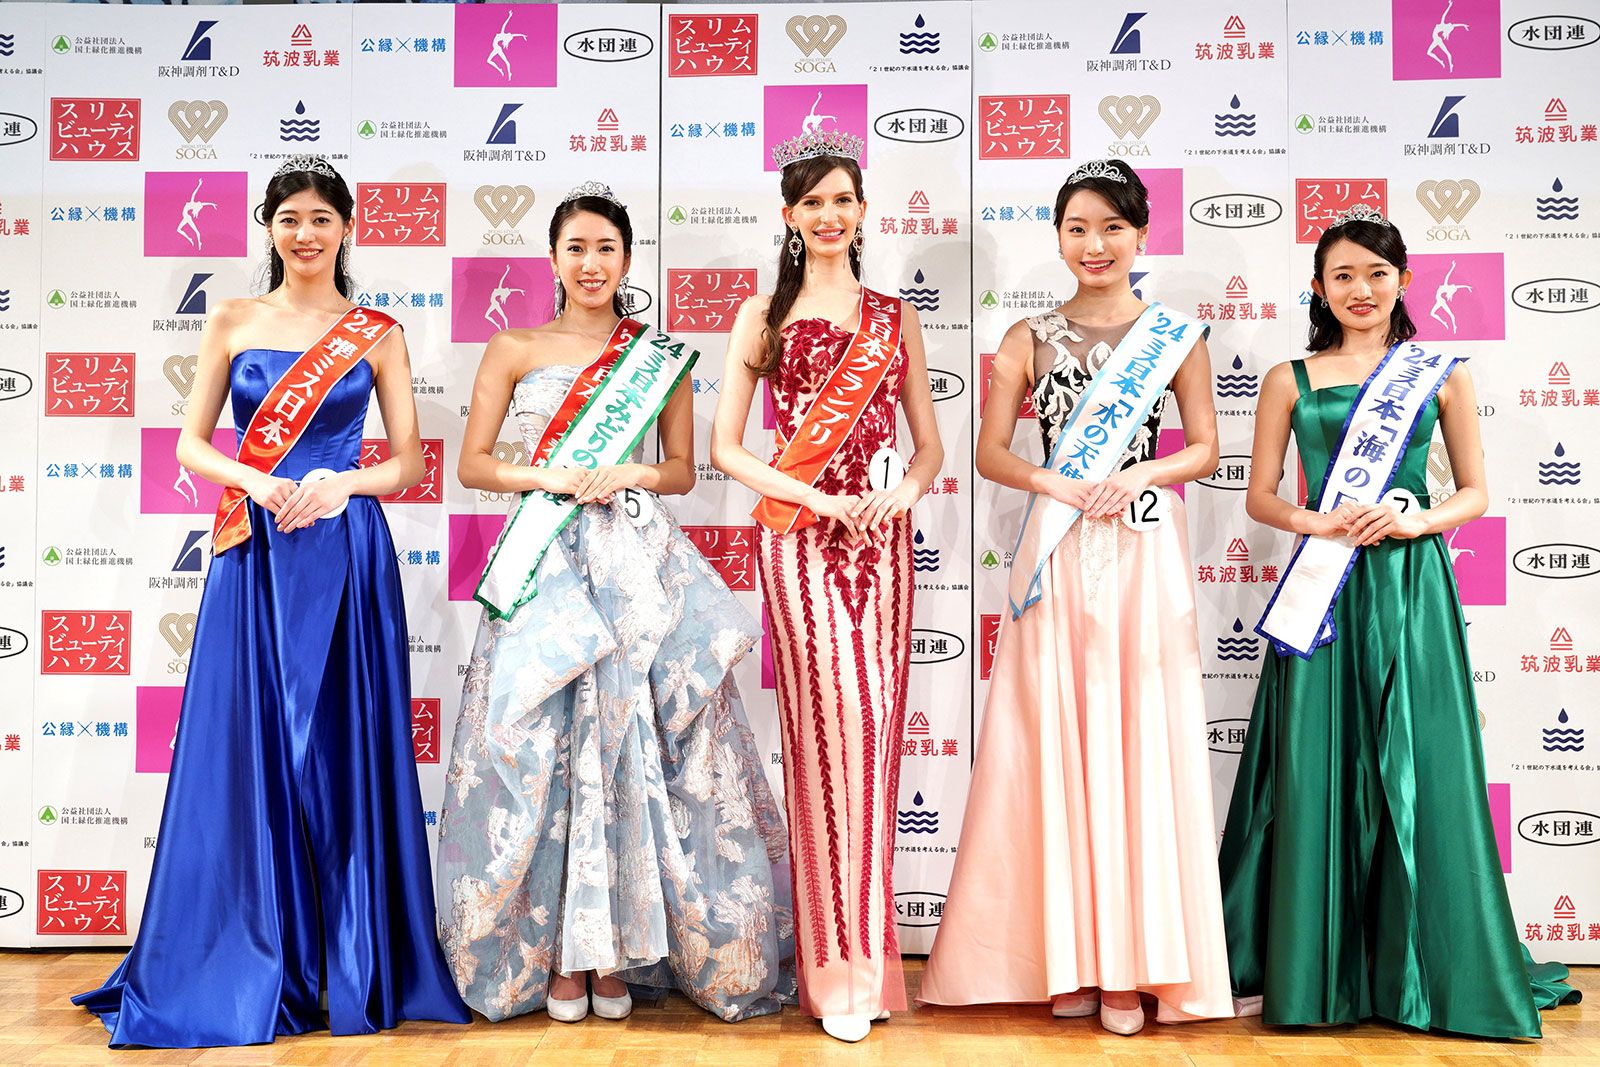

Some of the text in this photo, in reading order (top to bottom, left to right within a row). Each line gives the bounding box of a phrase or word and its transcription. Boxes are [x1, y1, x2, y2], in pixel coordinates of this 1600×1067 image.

[675, 19, 752, 35] スリム
[1522, 25, 1585, 41] 水団連
[74, 37, 125, 45] 公益社団法人
[578, 38, 637, 52] 水団連
[1002, 33, 1053, 41] 公益社団法人
[675, 37, 752, 55] ビューティ
[1195, 42, 1274, 60] 筑波乳業
[263, 50, 339, 67] 筑波乳業
[675, 56, 752, 72] ハウス
[794, 60, 836, 73] SOGA
[1087, 59, 1171, 71] 阪神調剤 T&D
[159, 66, 239, 77] 阪神調剤 T&D
[56, 102, 135, 120] スリム
[985, 100, 1065, 116] スリム
[56, 121, 135, 140] ビューティ
[888, 118, 947, 133] 水団連
[985, 117, 1065, 137] ビューティ
[1515, 125, 1597, 143] 筑波乳業
[56, 140, 135, 157] ハウス
[570, 135, 646, 152] 筑波乳業
[985, 138, 1065, 156] ハウス
[1108, 144, 1151, 156] SOGA
[1404, 143, 1490, 155] 阪神調剤 T&D
[176, 147, 217, 159] SOGA
[464, 150, 545, 161] 阪神調剤 T&D
[363, 187, 440, 205] スリム
[1303, 183, 1381, 201] スリム
[363, 206, 440, 225] ビューティ
[982, 206, 1050, 221] 公縁×機
[1204, 203, 1265, 219] 水団連
[363, 225, 440, 243] ハウス
[880, 217, 958, 235] 筑波乳業
[1426, 227, 1471, 241] SOGA
[483, 234, 525, 245] SOGA
[676, 272, 752, 290] スリム
[1004, 291, 1053, 299] 公益社団法人
[1527, 288, 1588, 303] 水団連
[1197, 303, 1276, 320] 筑波乳業
[153, 320, 202, 331] 阪神調剤
[52, 357, 129, 375] スリム
[52, 376, 129, 395] ビューティ
[52, 396, 129, 414] ハウス
[1520, 389, 1599, 407] 筑波乳業
[883, 455, 890, 490] 1
[624, 488, 641, 519] 5
[66, 548, 116, 556] 公益社団法人
[1527, 554, 1590, 569] 水団連
[149, 577, 198, 588] 阪神調剤
[1197, 566, 1278, 583] 筑波乳業
[48, 615, 125, 633] スリム
[48, 633, 125, 653] ビューティ
[48, 654, 125, 672] ハウス
[1532, 821, 1593, 836] 水団連
[43, 874, 121, 892] スリム
[43, 894, 121, 913] ビューティ
[43, 914, 121, 932] ハウス
